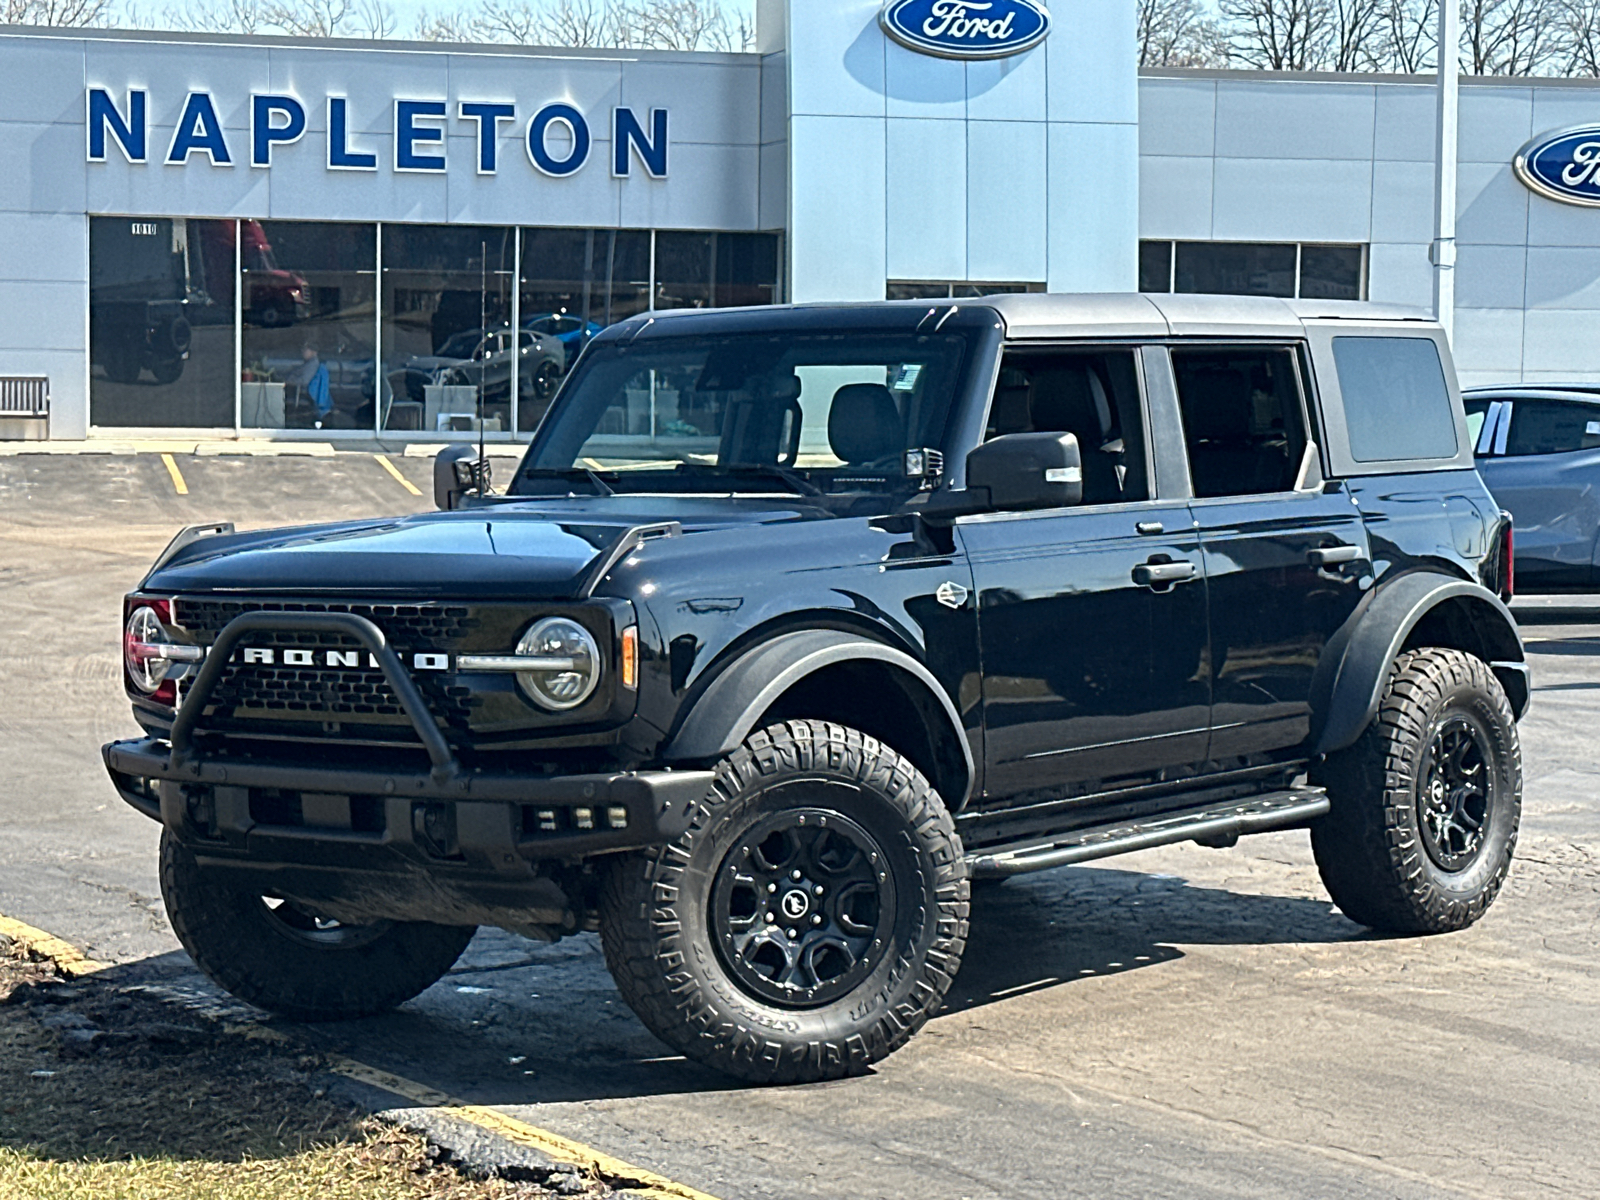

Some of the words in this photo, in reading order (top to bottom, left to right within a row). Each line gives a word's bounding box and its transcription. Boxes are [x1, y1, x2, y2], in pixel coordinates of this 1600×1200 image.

[923, 0, 1016, 39] Ford
[86, 87, 669, 179] NAPLETON
[206, 645, 449, 670] RONO
